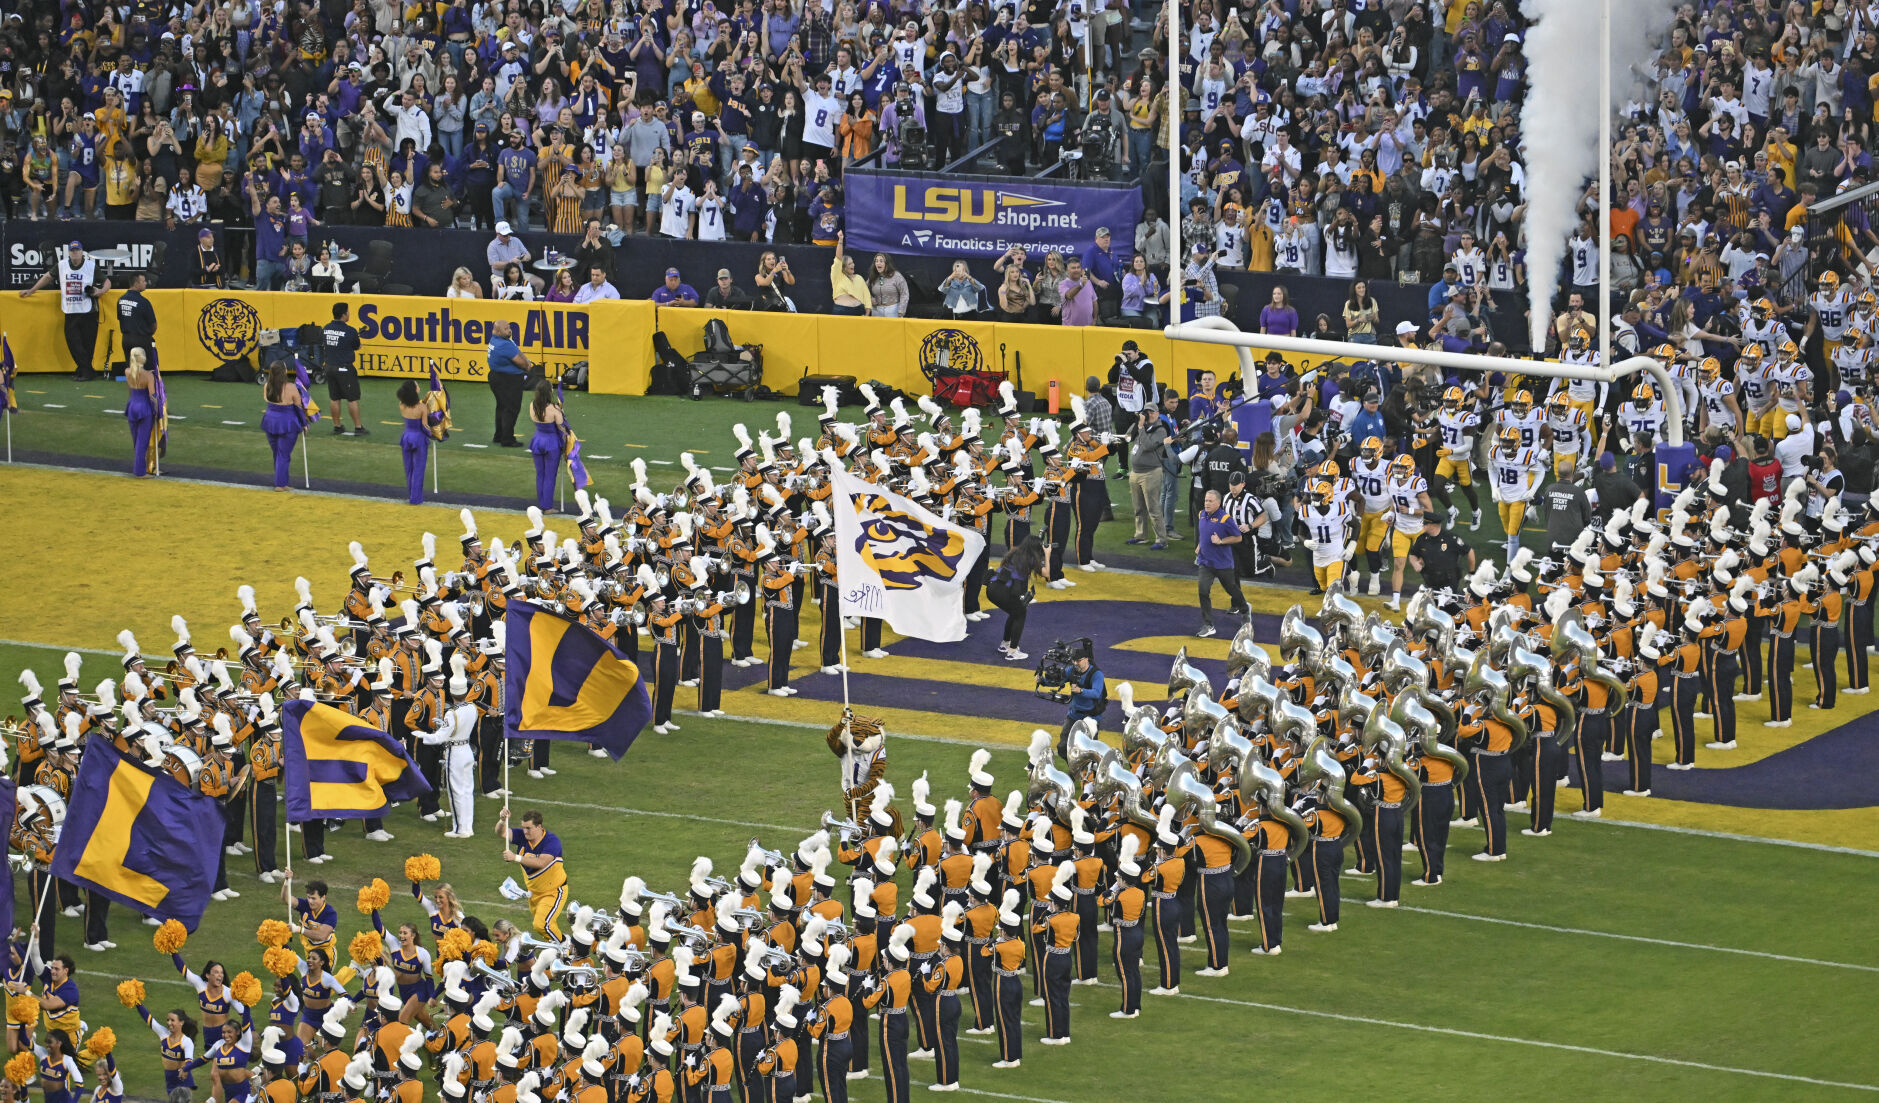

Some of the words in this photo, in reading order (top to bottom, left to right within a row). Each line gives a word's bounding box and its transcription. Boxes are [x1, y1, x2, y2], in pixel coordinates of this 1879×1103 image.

[875, 73, 887, 91] 7
[1751, 77, 1761, 95] 7
[587, 102, 594, 115] 1
[1207, 92, 1218, 109] 9
[815, 109, 828, 127] 8
[595, 136, 606, 154] 9
[688, 136, 711, 148] LSU
[83, 148, 94, 165] 8
[504, 156, 527, 169] LSU
[1436, 177, 1444, 192] 7
[182, 202, 192, 219] 9
[674, 199, 684, 217] 3
[705, 206, 717, 225] 7
[893, 185, 995, 224] LSU
[997, 207, 1078, 231] shop.net
[1269, 207, 1280, 224] 9
[902, 234, 912, 247] A
[935, 234, 994, 250] Fanatics
[1224, 232, 1235, 249] 3
[1286, 245, 1298, 262] 18
[1576, 249, 1587, 268] 9
[1463, 264, 1475, 284] 9
[1498, 263, 1507, 282] 9
[1820, 310, 1842, 328] 86
[523, 309, 589, 350] AIR
[359, 353, 460, 376] HEATING
[467, 360, 483, 376] &
[1209, 461, 1230, 472] POLICE
[1500, 467, 1518, 484] 18
[1659, 463, 1681, 491] L
[1359, 475, 1381, 496] 70
[1549, 491, 1574, 500] LANDMARK
[1317, 525, 1331, 543] 11
[73, 758, 170, 909] L
[394, 958, 416, 972] LSU
[200, 1000, 222, 1013] LSU
[215, 1056, 235, 1066] LSU
